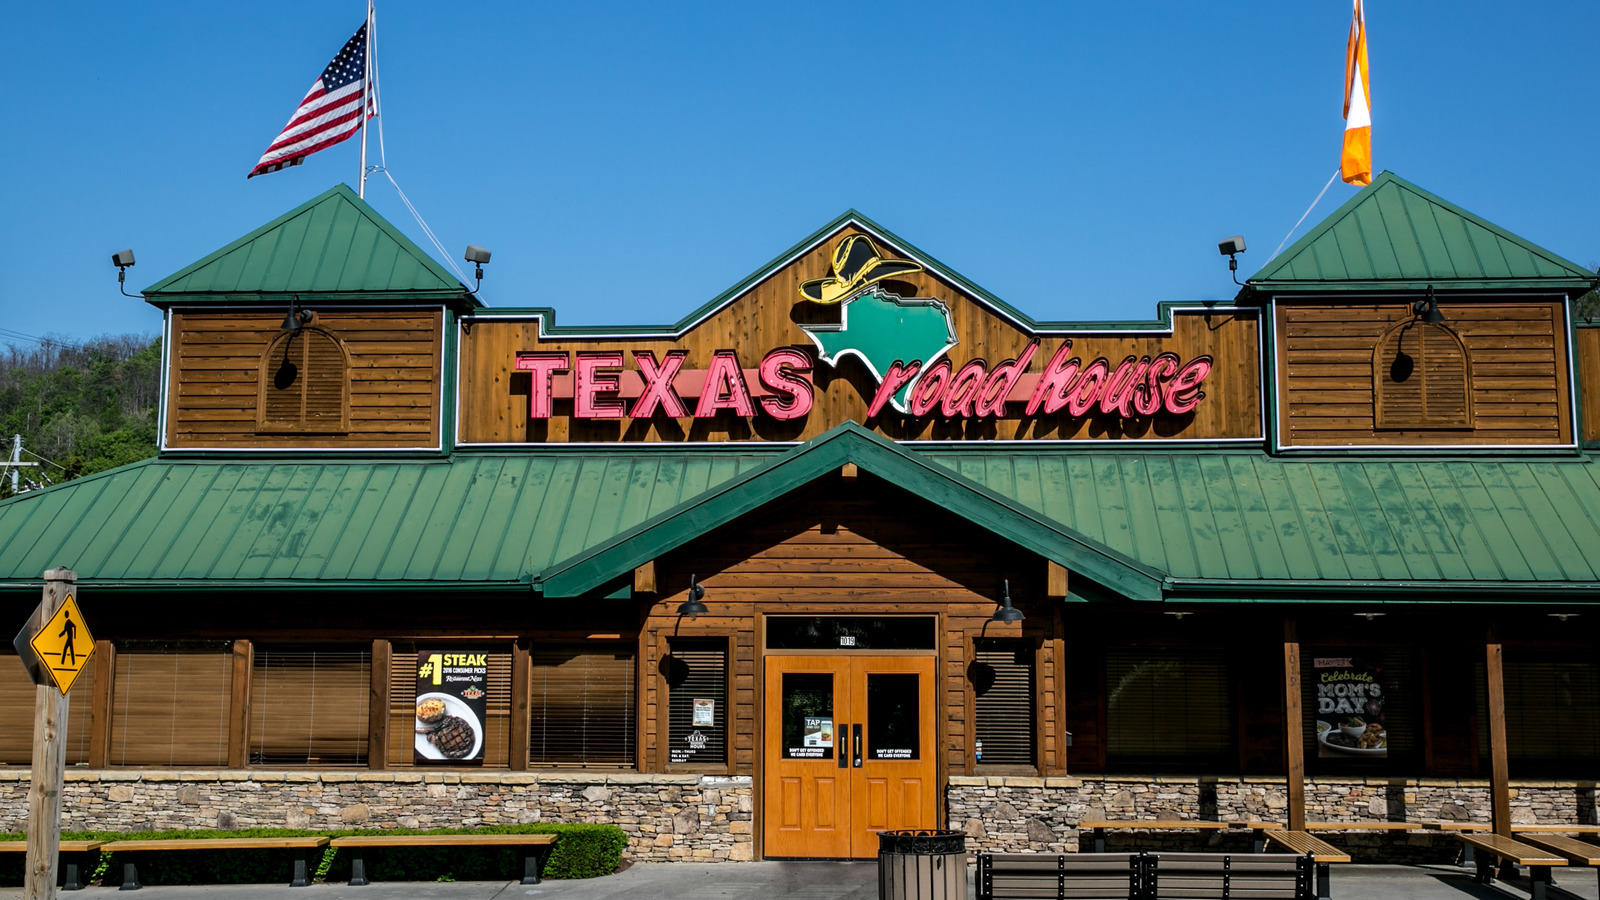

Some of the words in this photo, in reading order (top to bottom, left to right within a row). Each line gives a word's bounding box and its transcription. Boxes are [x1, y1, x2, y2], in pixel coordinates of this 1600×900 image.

[515, 346, 815, 420] TEXAS
[867, 336, 1041, 418] road
[1025, 338, 1214, 418] house
[840, 636, 855, 646] 1019
[443, 654, 487, 666] STEAK
[419, 654, 442, 685] #1
[1321, 670, 1374, 682] Celebrate
[1317, 683, 1382, 697] MOM'S
[1318, 697, 1368, 714] DAY
[687, 735, 707, 743] TEXAS
